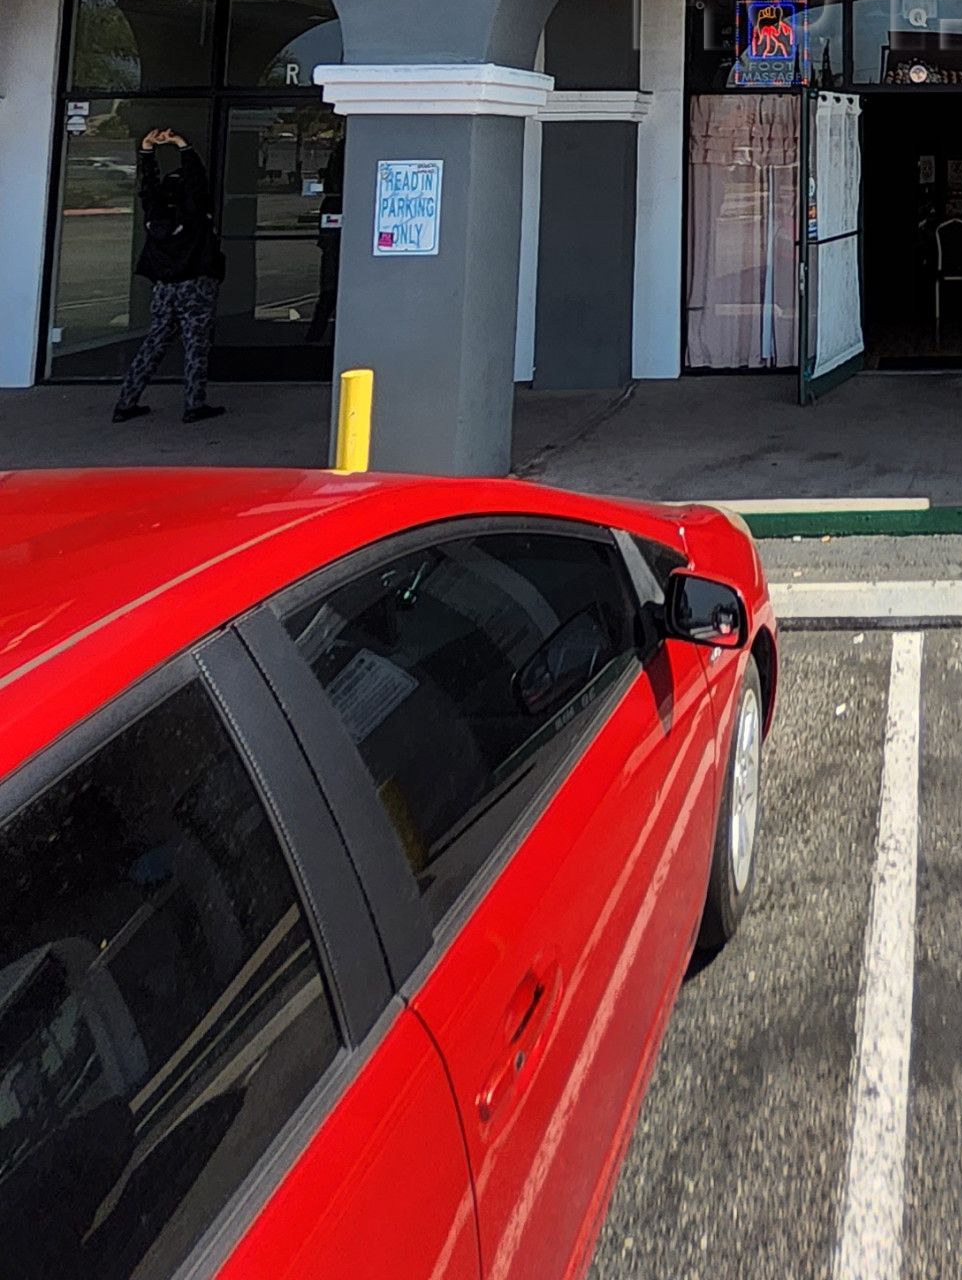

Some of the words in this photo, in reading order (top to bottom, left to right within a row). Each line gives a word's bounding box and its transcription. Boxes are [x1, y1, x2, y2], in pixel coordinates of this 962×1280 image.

[908, 8, 928, 28] Q
[285, 63, 299, 85] R
[741, 71, 803, 81] MASSAGE
[748, 61, 793, 71] FOOT
[381, 197, 434, 218] PARKING
[392, 223, 423, 245] ONLY
